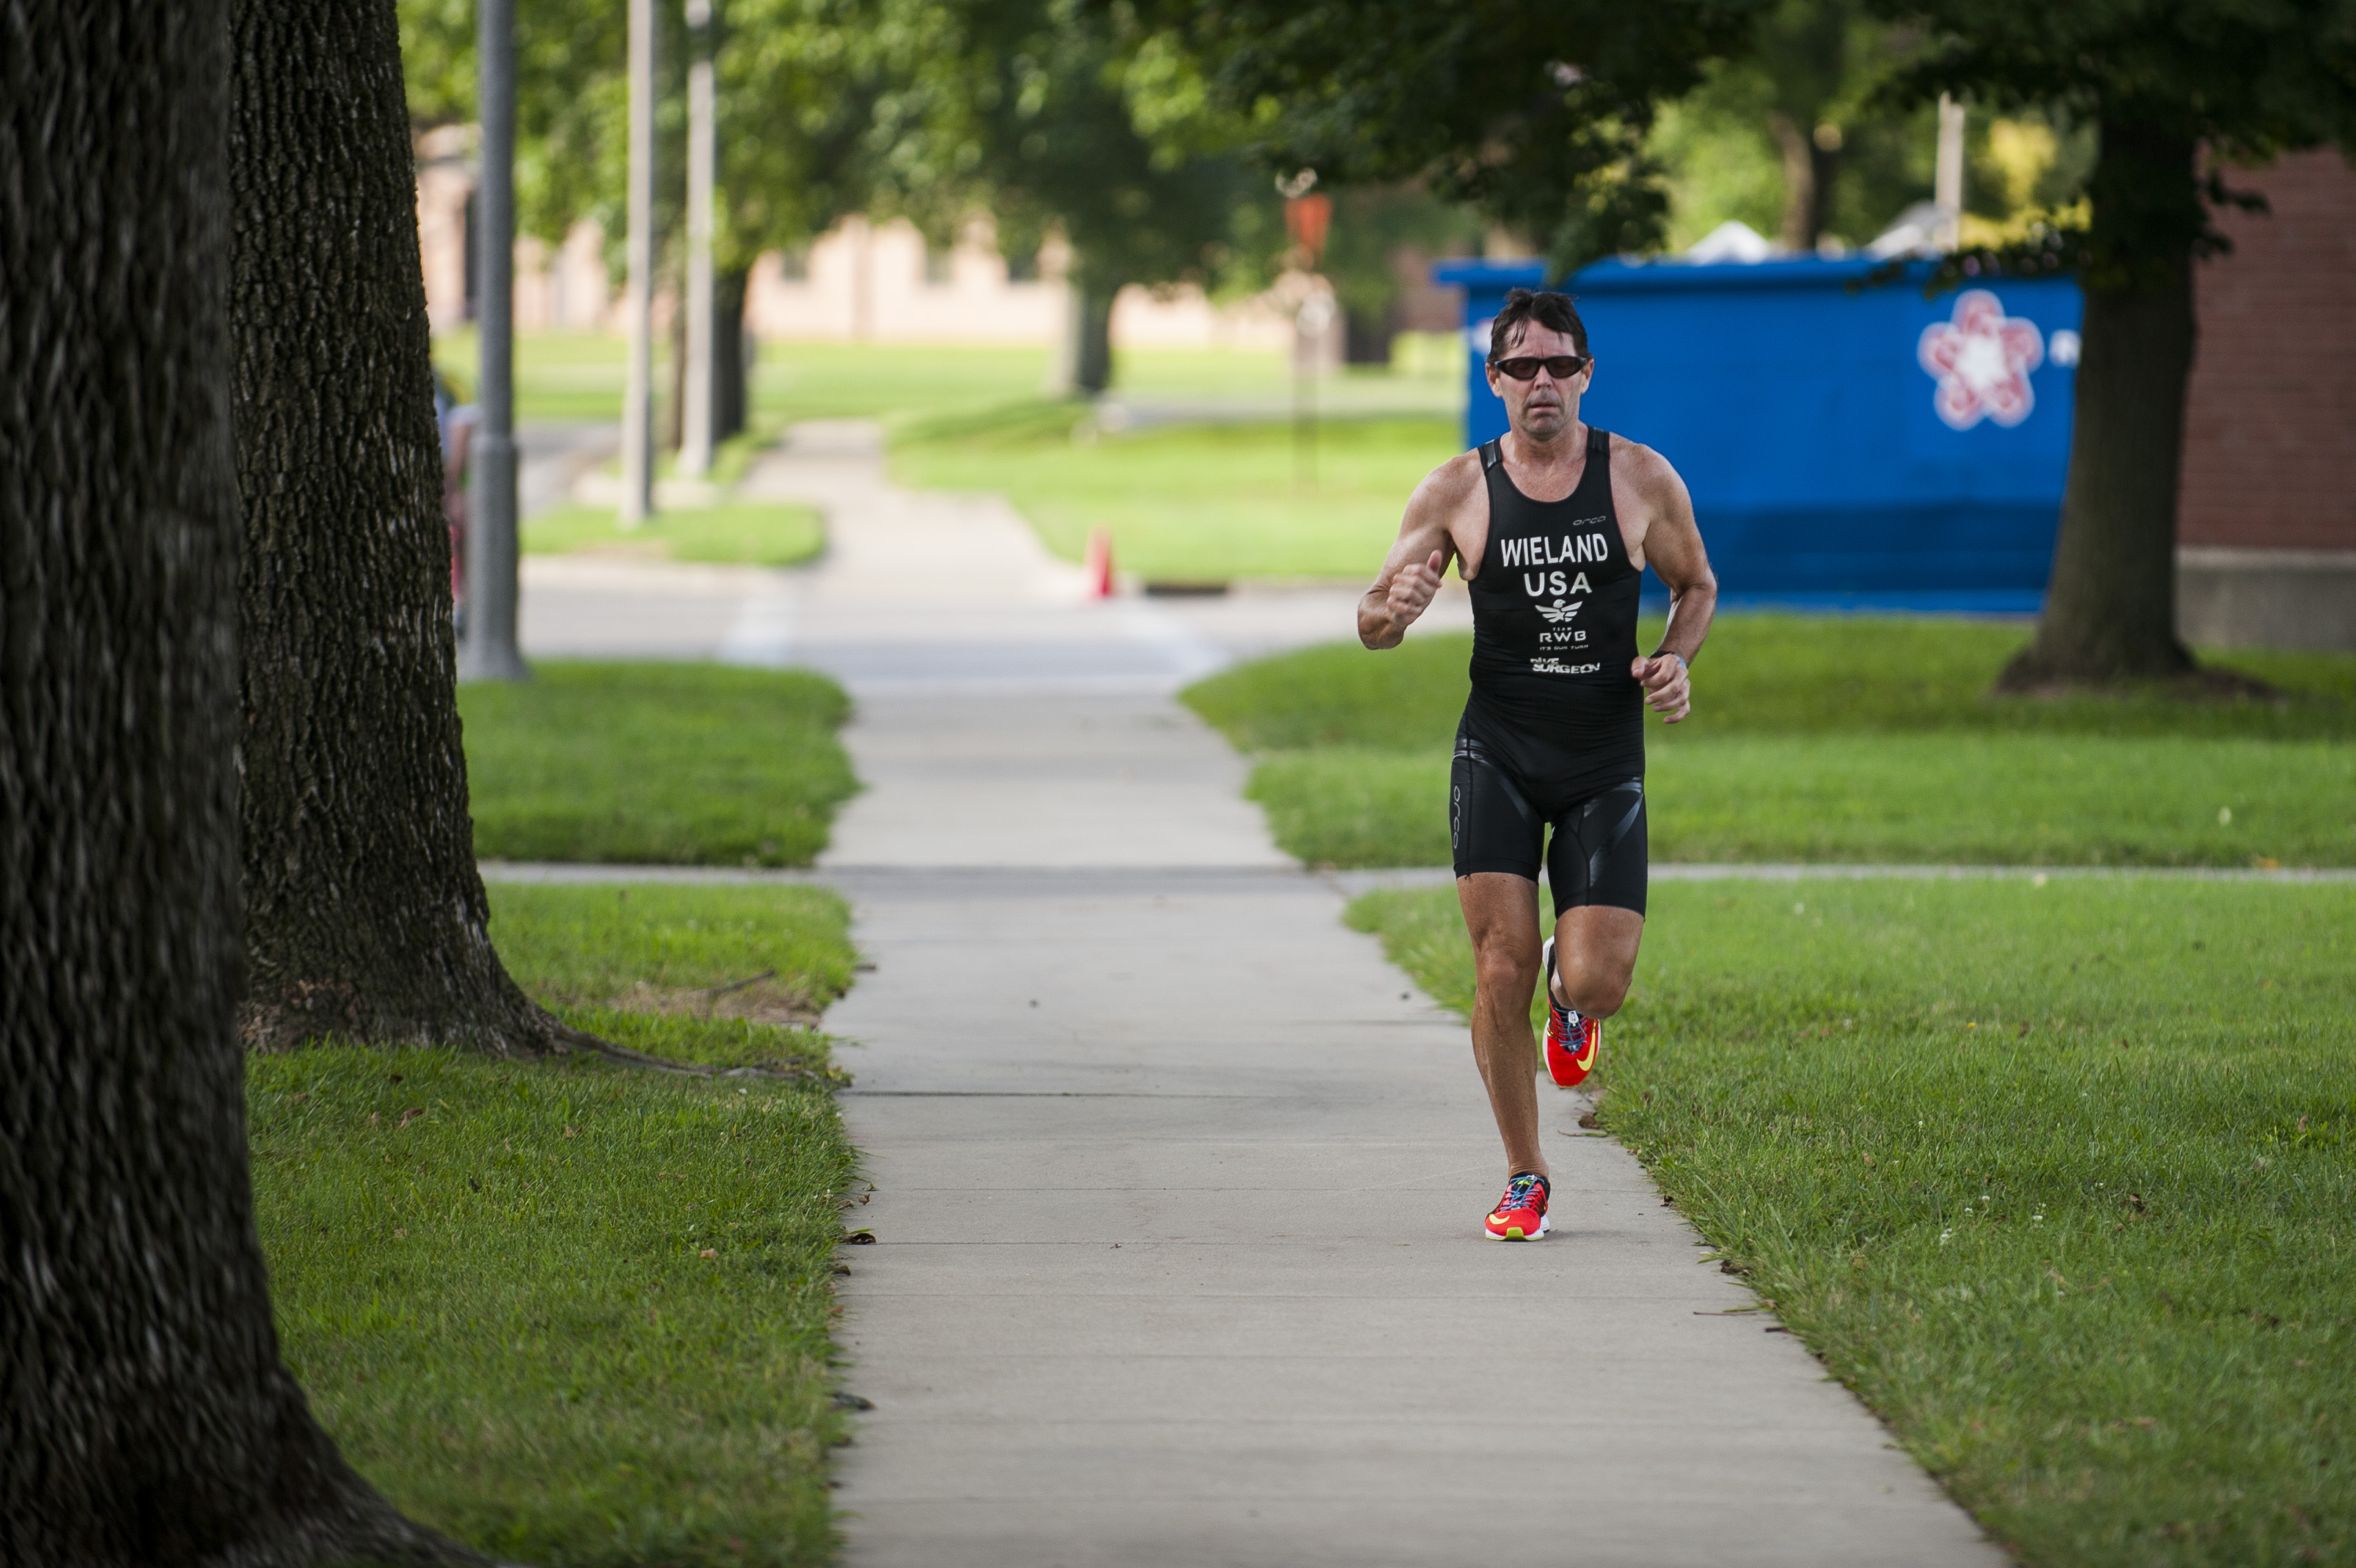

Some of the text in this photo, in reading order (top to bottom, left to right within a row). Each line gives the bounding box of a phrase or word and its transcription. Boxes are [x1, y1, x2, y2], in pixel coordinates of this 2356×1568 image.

[1573, 515, 1606, 526] orca
[1500, 533, 1609, 567] WIELAND
[1524, 570, 1593, 597] USA
[1540, 630, 1587, 643] RWB
[1532, 662, 1600, 674] SURGEON
